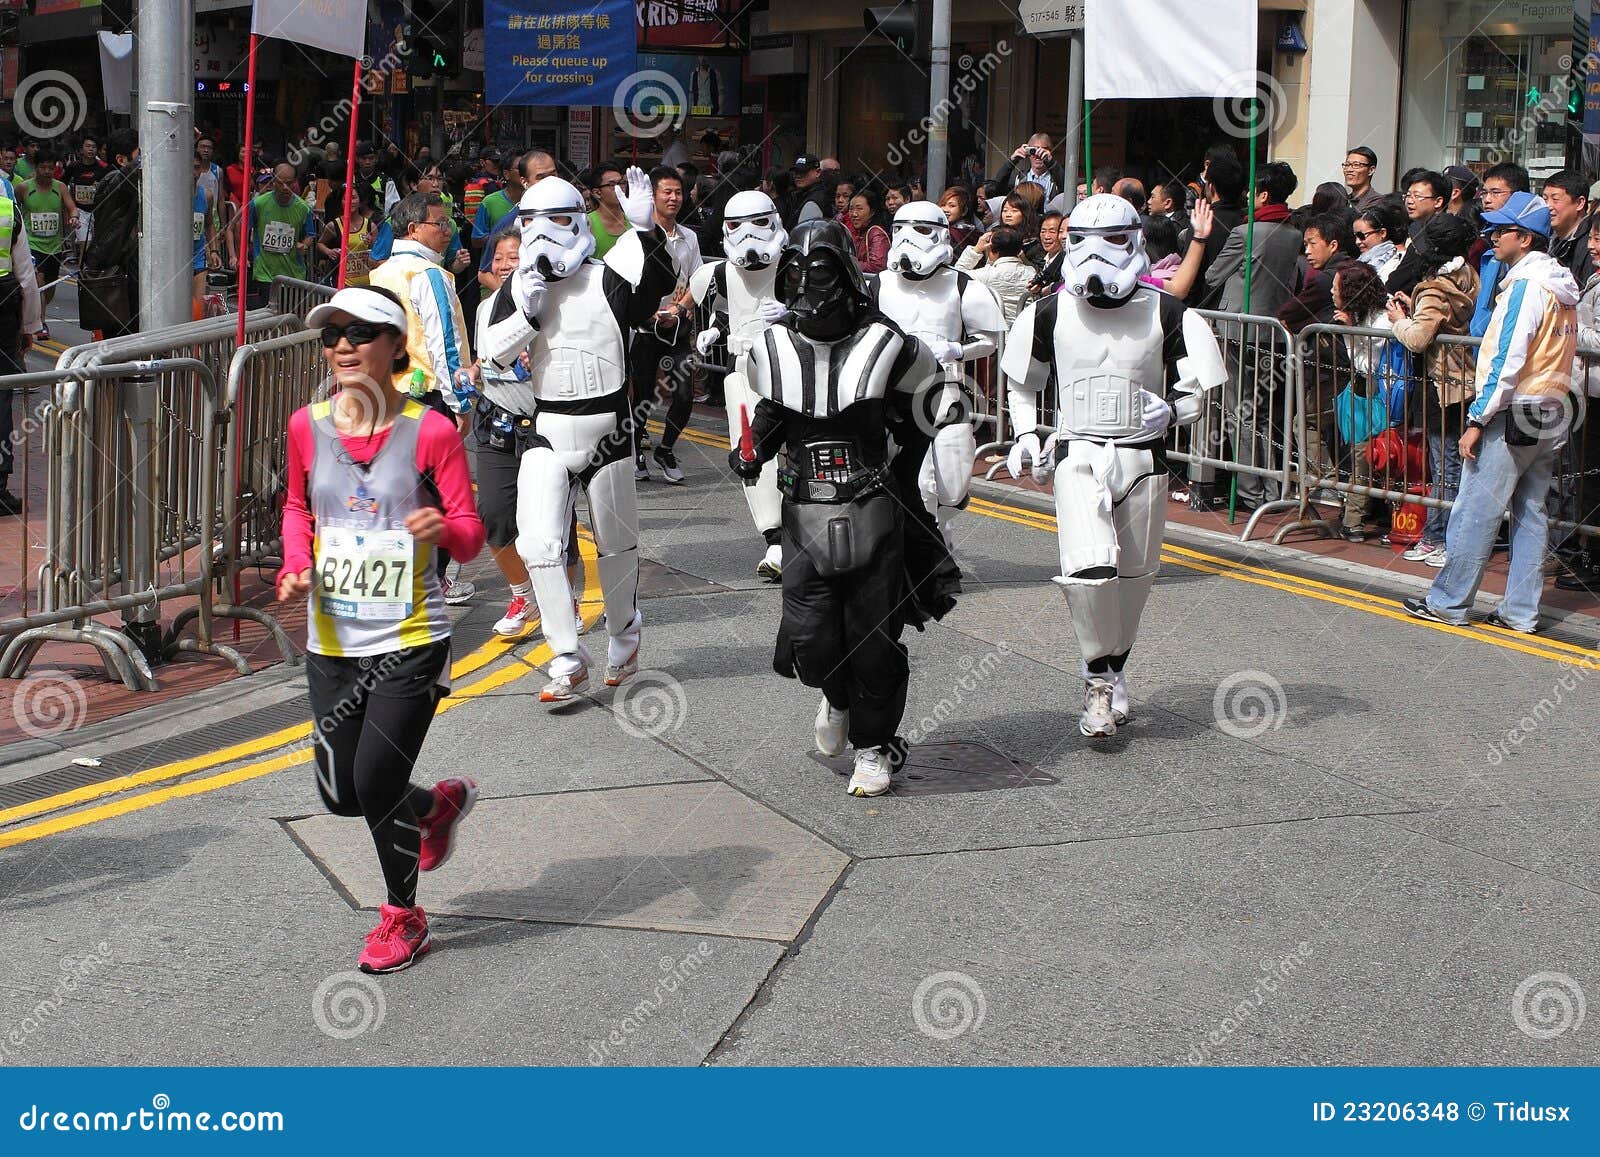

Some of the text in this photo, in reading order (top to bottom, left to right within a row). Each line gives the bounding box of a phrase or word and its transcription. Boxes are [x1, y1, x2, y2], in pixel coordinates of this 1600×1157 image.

[1521, 4, 1573, 19] Fragrance
[508, 14, 611, 30] 請在此排隊等候
[512, 55, 608, 69] Please queue up
[525, 71, 594, 86] for crossing
[33, 219, 58, 231] B1729
[265, 233, 293, 249] 26198
[322, 557, 407, 598] B2427
